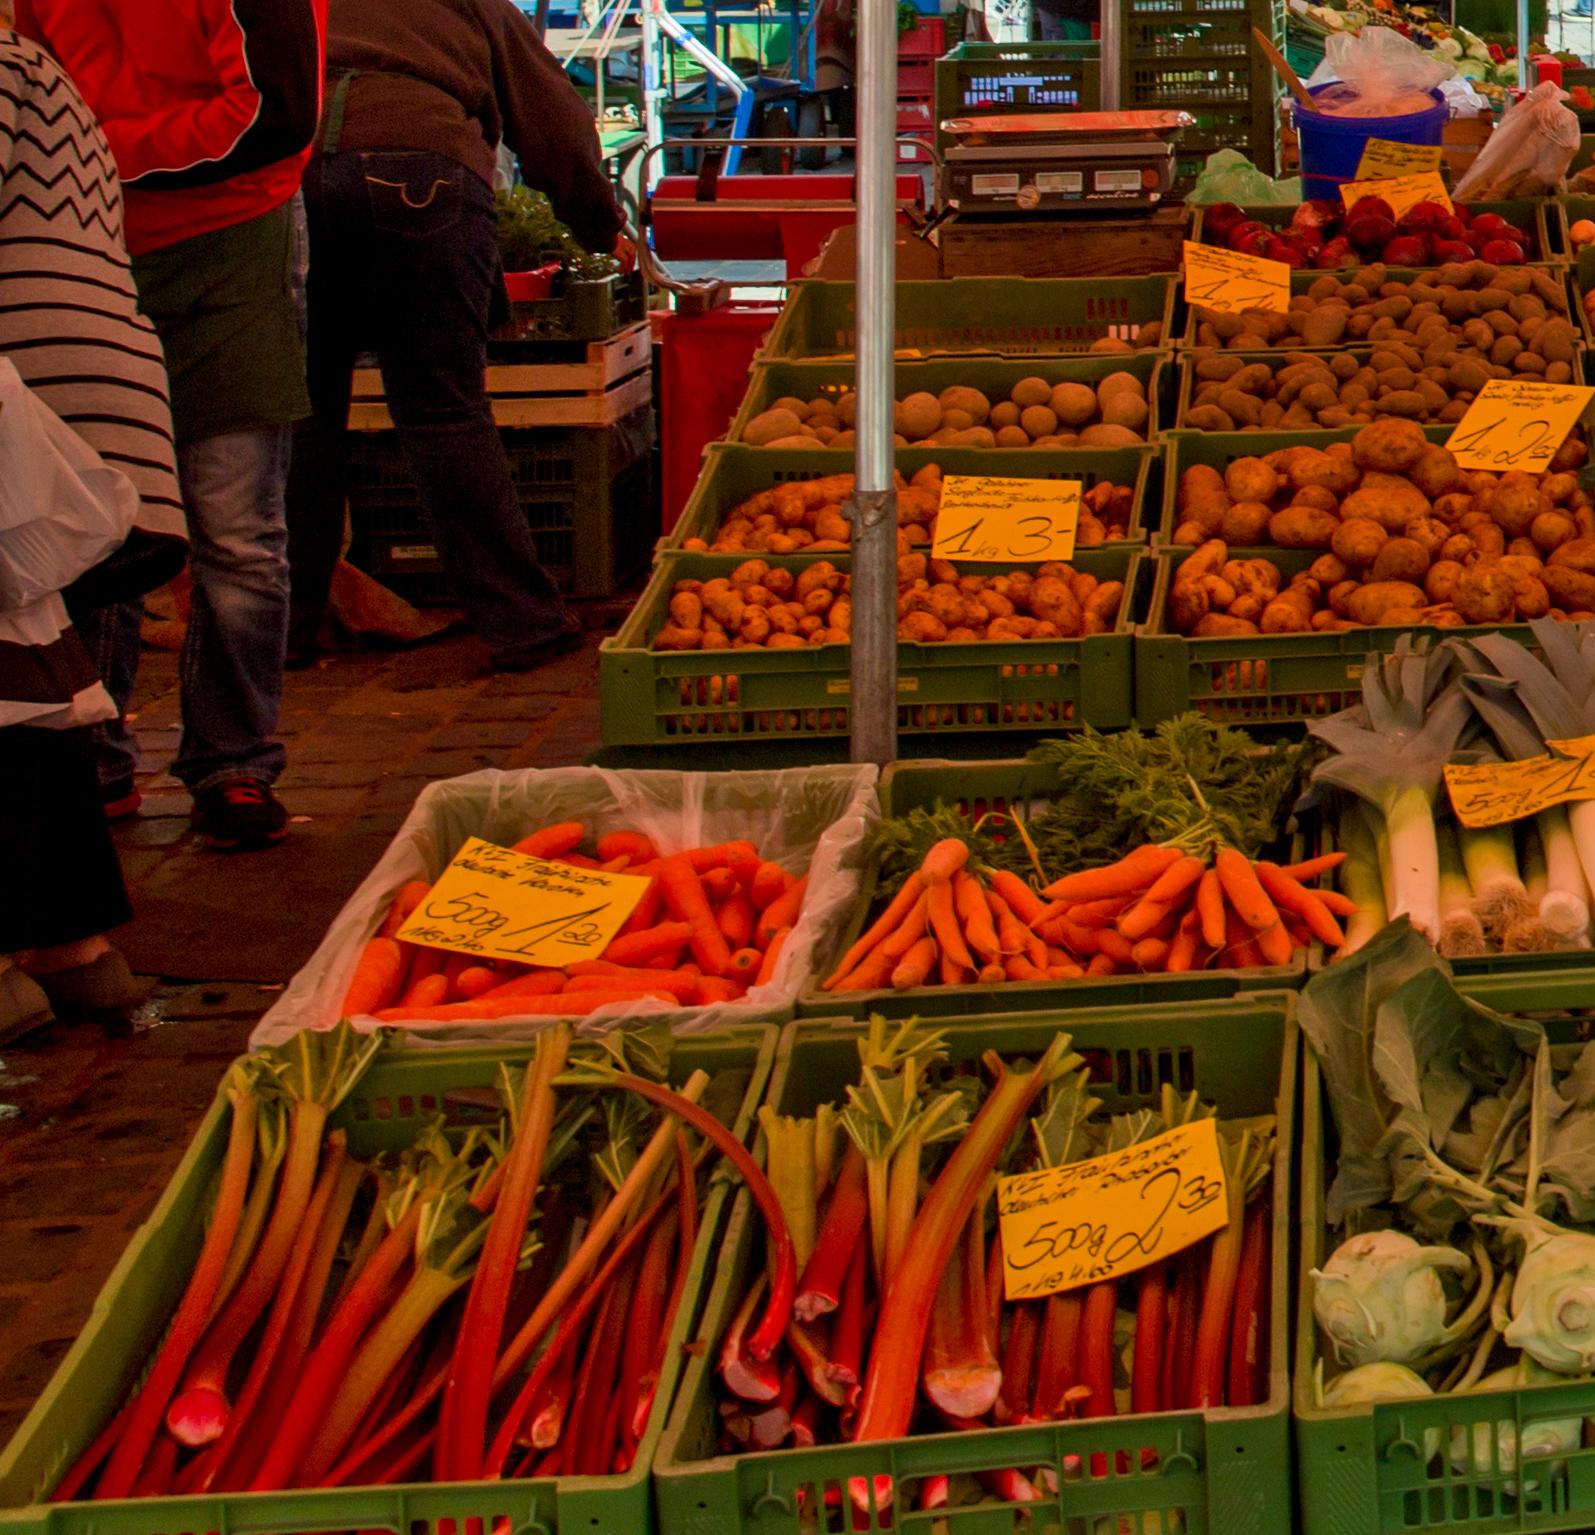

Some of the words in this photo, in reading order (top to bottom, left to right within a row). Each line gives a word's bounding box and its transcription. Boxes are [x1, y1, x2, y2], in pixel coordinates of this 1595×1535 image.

[937, 517, 985, 555] 1
[424, 892, 510, 939] 500g
[1007, 1221, 1108, 1270] 500g
[1104, 1166, 1181, 1264] 2
[1177, 1175, 1223, 1214] 30
